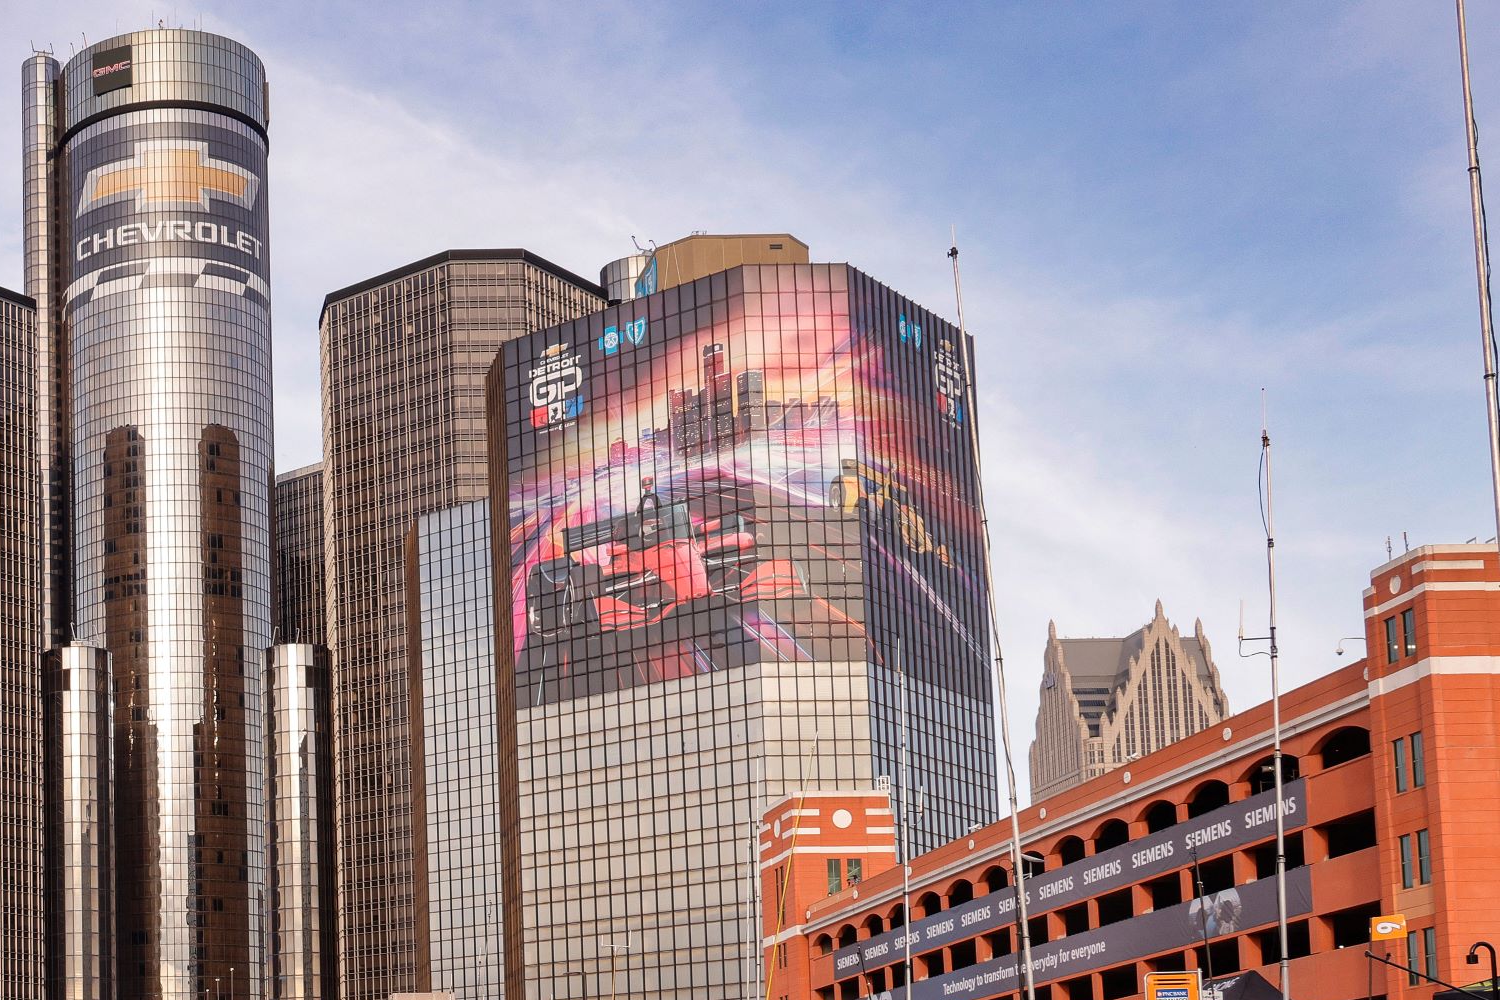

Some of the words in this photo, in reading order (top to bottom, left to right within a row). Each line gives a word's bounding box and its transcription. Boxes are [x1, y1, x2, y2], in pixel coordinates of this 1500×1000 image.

[92, 60, 131, 78] GMC
[76, 220, 263, 261] CHEVROLET
[528, 354, 582, 379] DETROIT
[529, 366, 583, 407] GP
[836, 951, 860, 970] SIEMENS
[864, 942, 889, 961] SIEMENS
[894, 930, 920, 951] SIEENS
[926, 918, 955, 939] SIEMENS
[961, 905, 991, 928] SIEMENS
[999, 891, 1031, 915] SIEMS
[1039, 876, 1074, 900] SIEMENS
[1083, 858, 1122, 886] SIEMENS
[1131, 840, 1174, 869] SIEMENS
[1185, 819, 1232, 850] SIEMENS
[1244, 796, 1297, 830] SIEMNS
[943, 975, 976, 996] Technology
[976, 974, 984, 986] to
[984, 965, 1015, 984] transform
[1030, 953, 1058, 971] veryday
[1059, 949, 1070, 963] for
[1071, 941, 1106, 960] everyone
